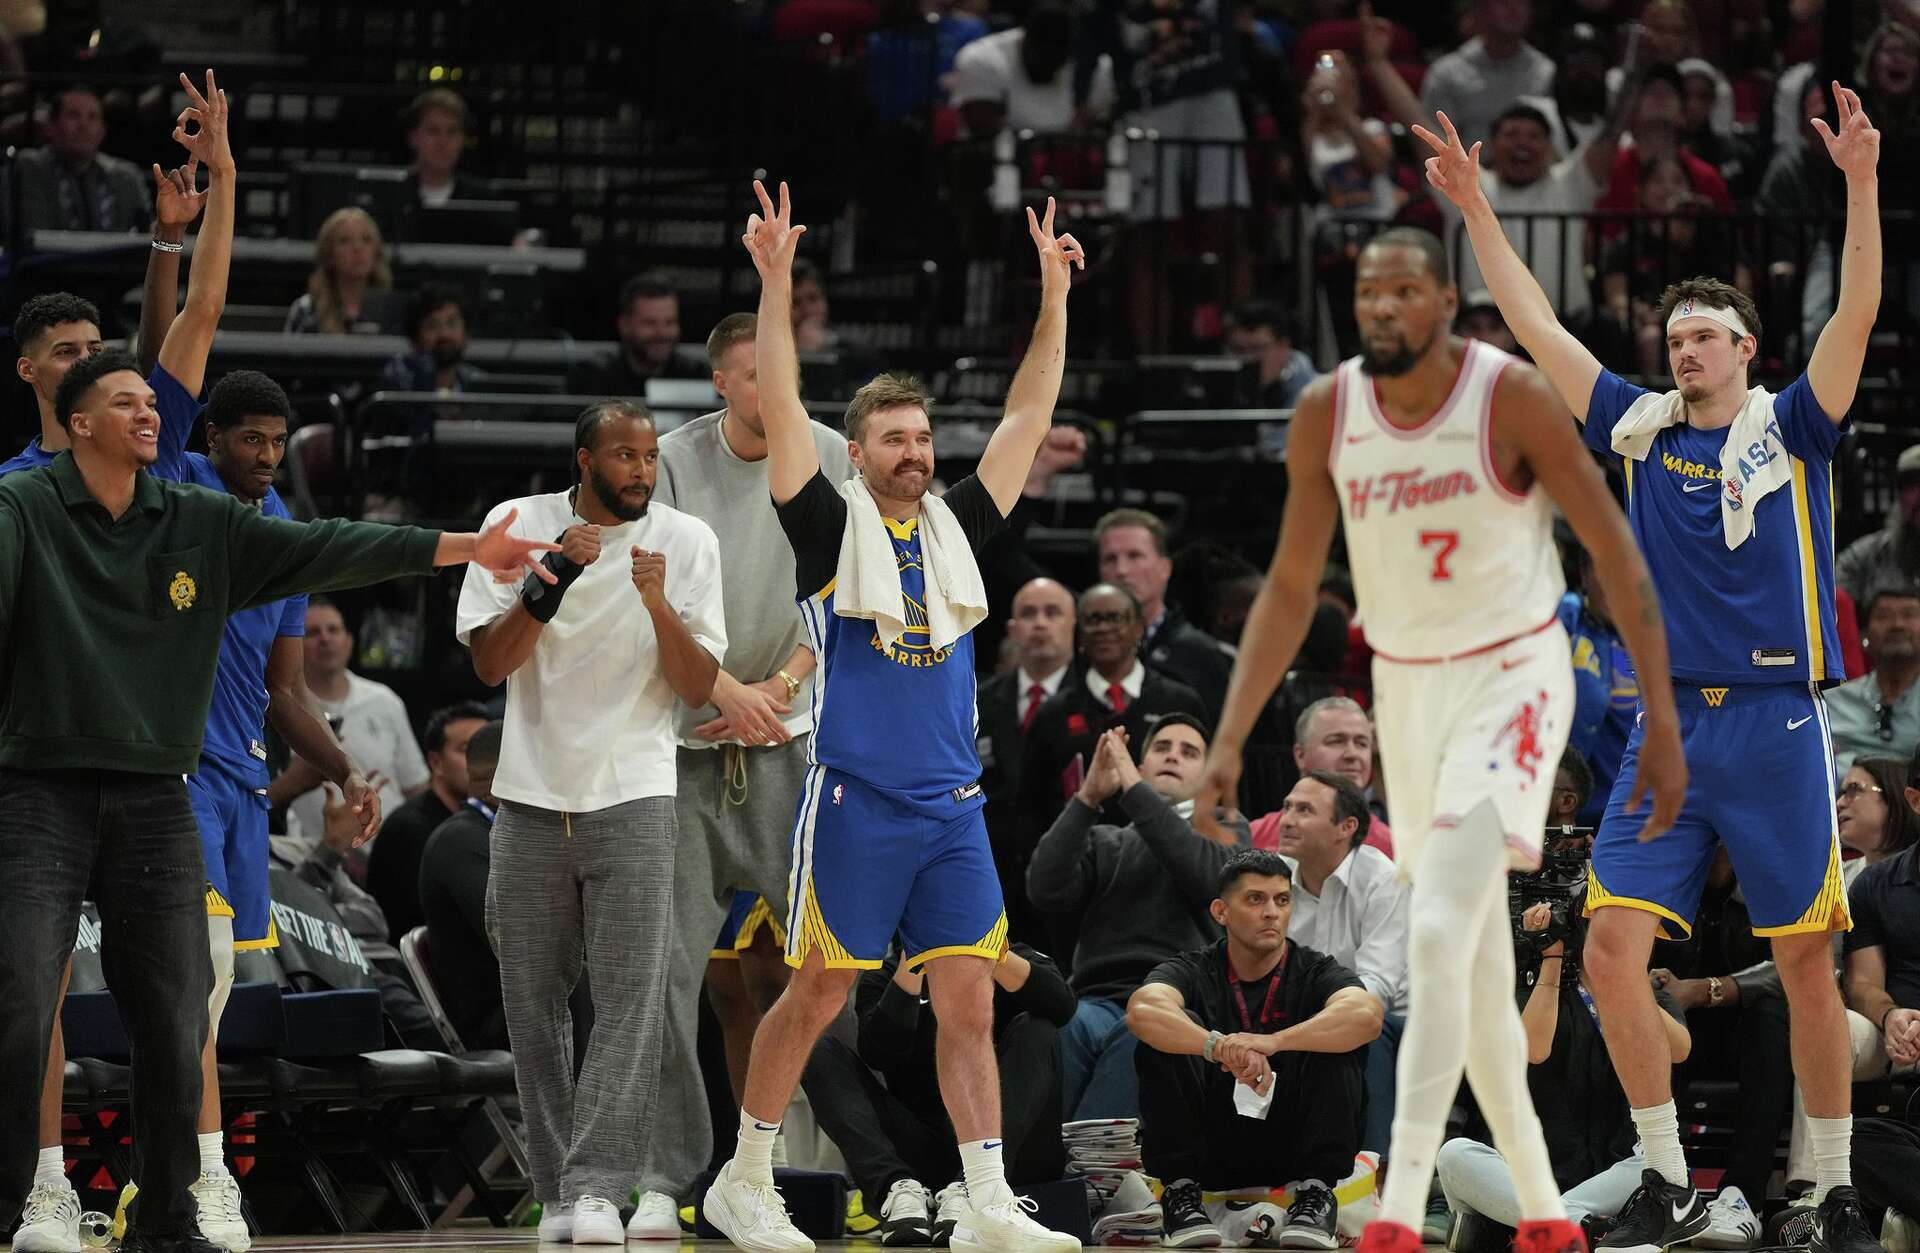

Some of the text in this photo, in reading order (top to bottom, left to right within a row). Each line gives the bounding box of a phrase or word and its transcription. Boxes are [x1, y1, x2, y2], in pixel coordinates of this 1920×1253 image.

[1346, 467, 1478, 519] H-Town
[1419, 529, 1458, 581] 7
[296, 911, 333, 956] THE
